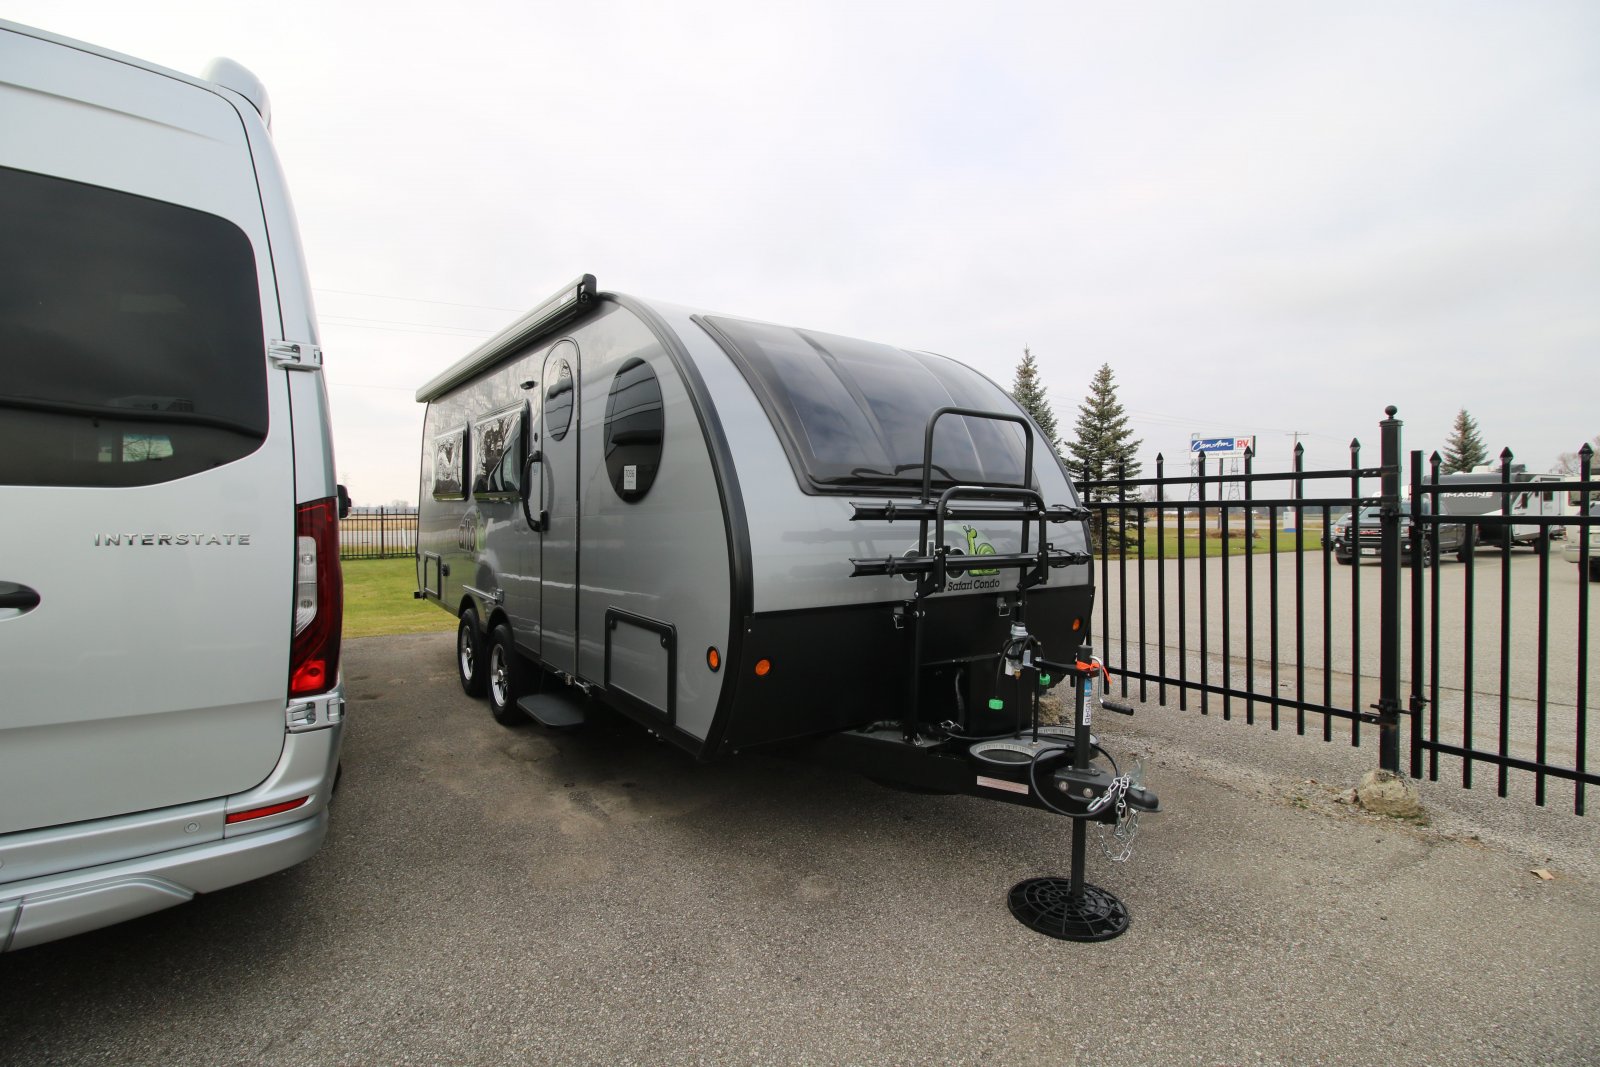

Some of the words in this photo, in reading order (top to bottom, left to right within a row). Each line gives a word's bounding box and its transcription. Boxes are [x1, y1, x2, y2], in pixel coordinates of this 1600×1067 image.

[1237, 439, 1249, 448] RV
[94, 533, 250, 546] INTERSTATE
[948, 580, 973, 592] Safari
[974, 579, 1000, 590] Condo
